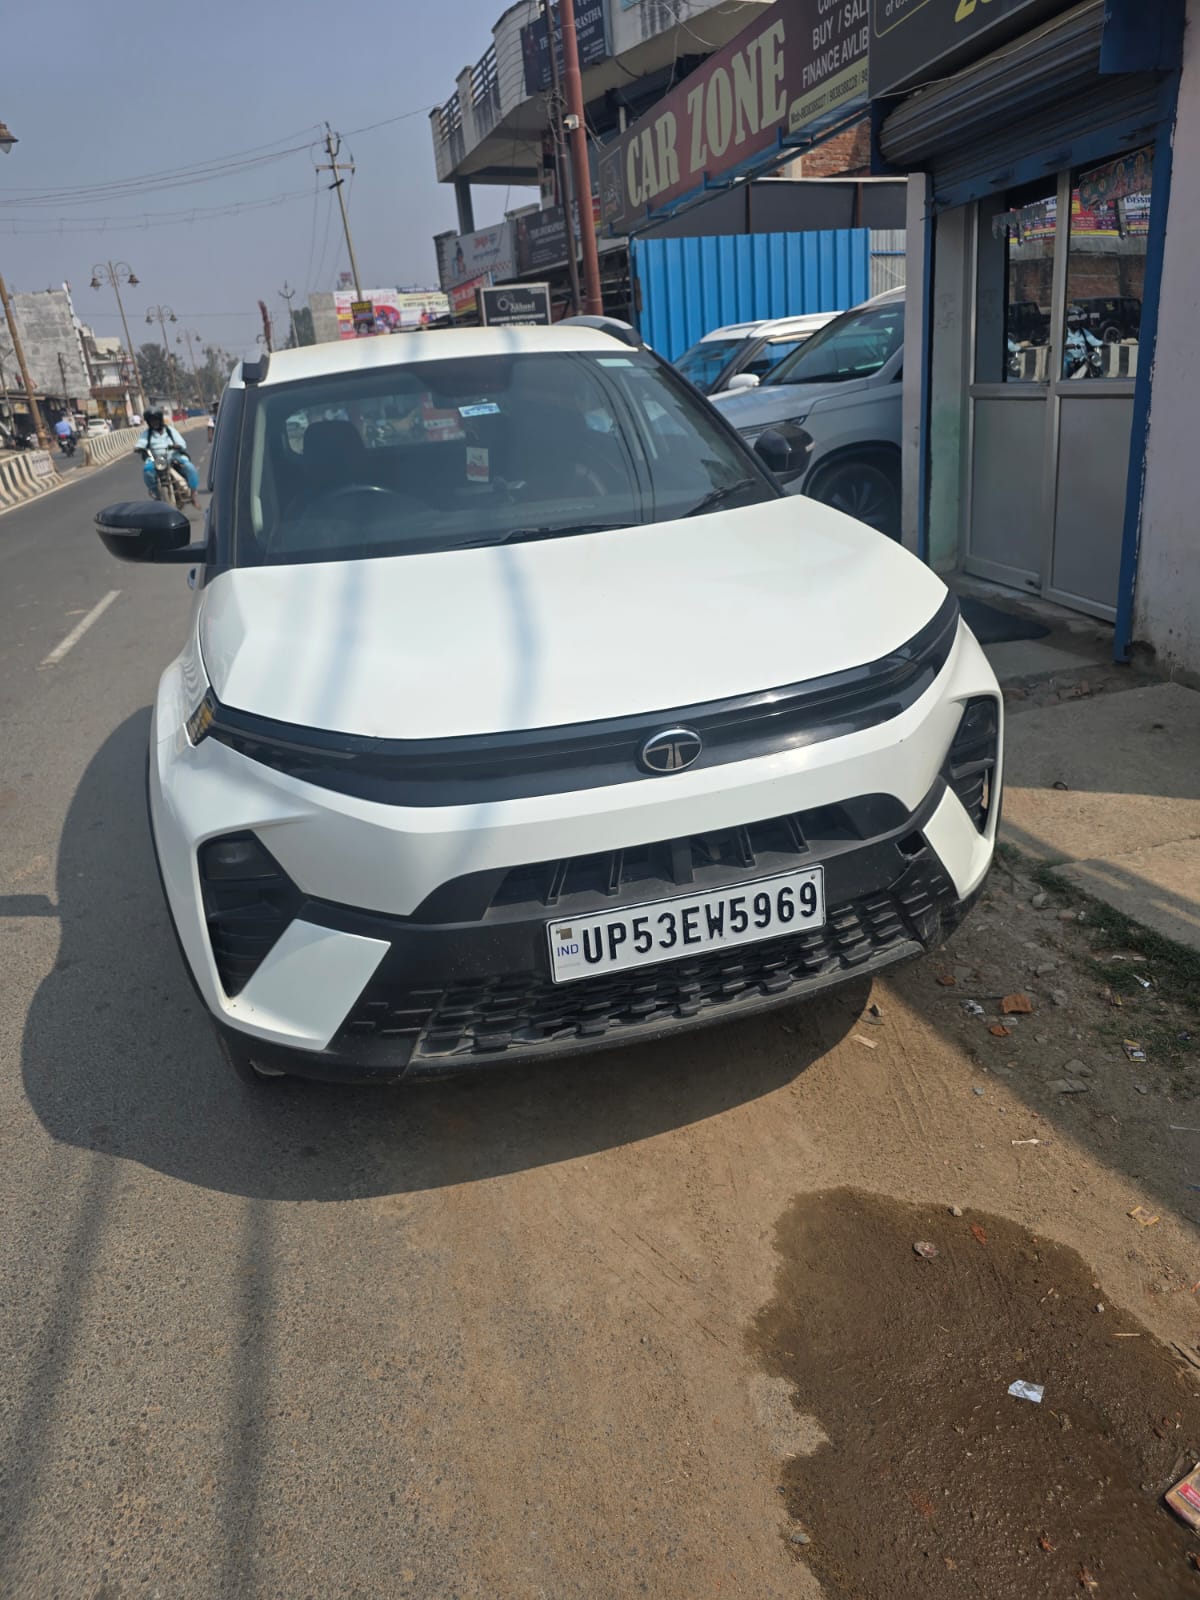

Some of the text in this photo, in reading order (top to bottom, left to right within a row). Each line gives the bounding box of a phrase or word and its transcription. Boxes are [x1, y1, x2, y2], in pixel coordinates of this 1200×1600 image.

[812, 15, 834, 50] BUY
[802, 44, 840, 89] FINANCE
[626, 18, 788, 208] CAR ZONE
[582, 881, 818, 964] UP53EW5969
[556, 943, 579, 957] IND
